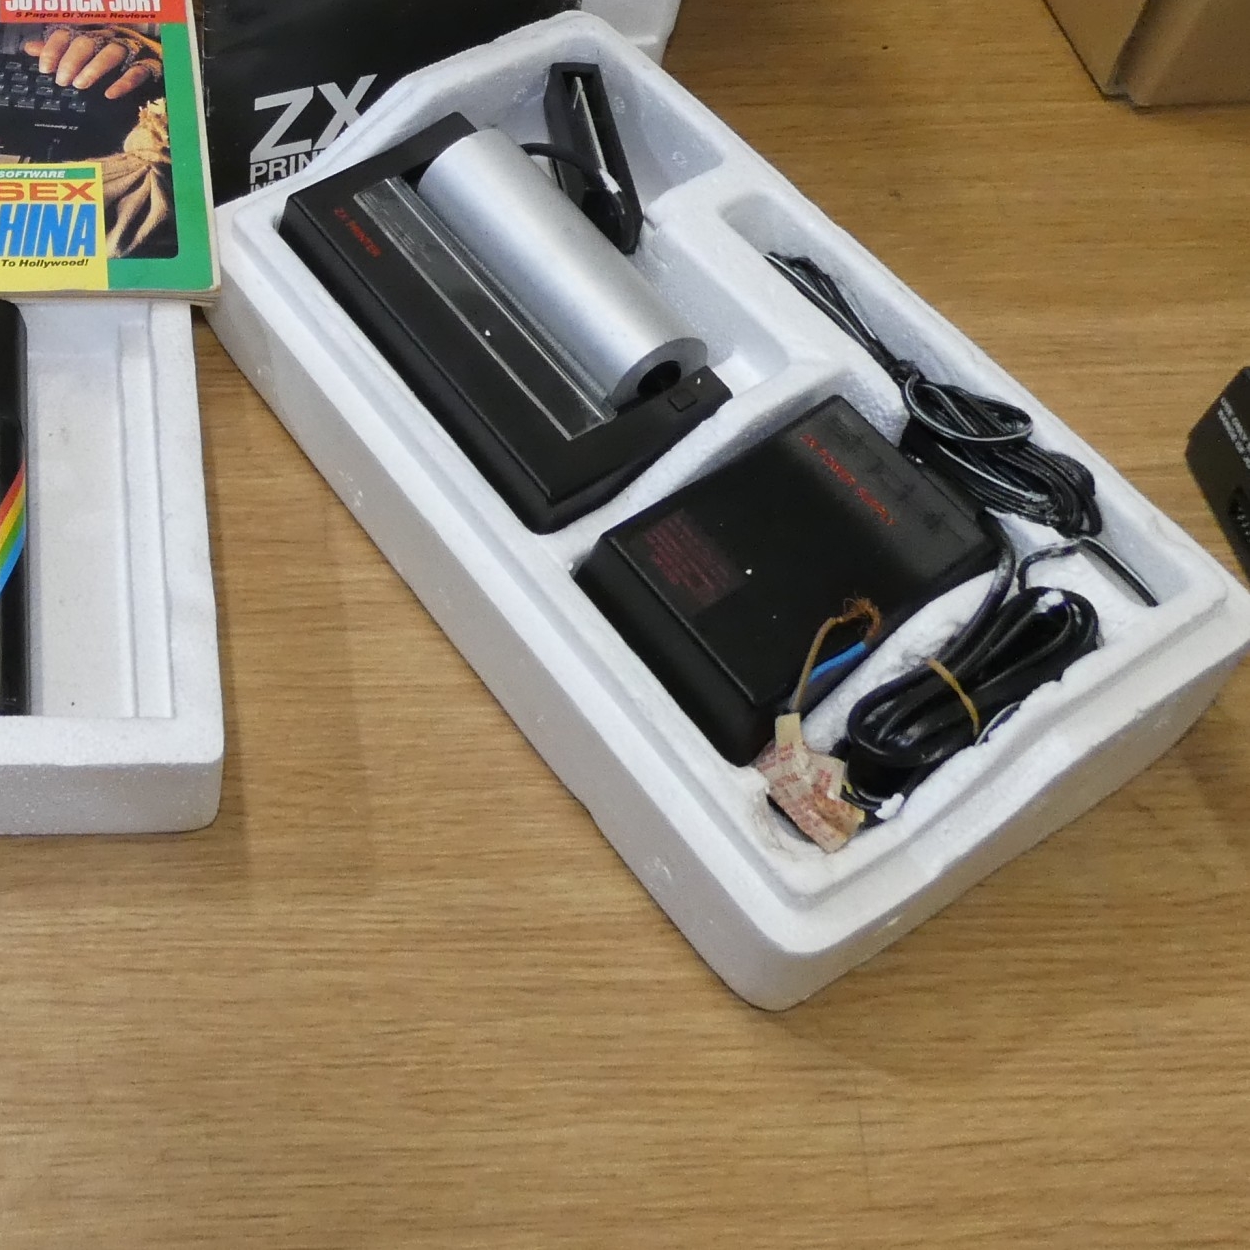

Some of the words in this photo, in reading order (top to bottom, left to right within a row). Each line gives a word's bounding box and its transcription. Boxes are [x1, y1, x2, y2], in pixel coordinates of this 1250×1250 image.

[250, 73, 378, 163] ZX
[250, 152, 319, 184] PRIN
[29, 182, 96, 201] EX
[1, 259, 16, 267] To
[19, 259, 89, 268] Hollywood!
